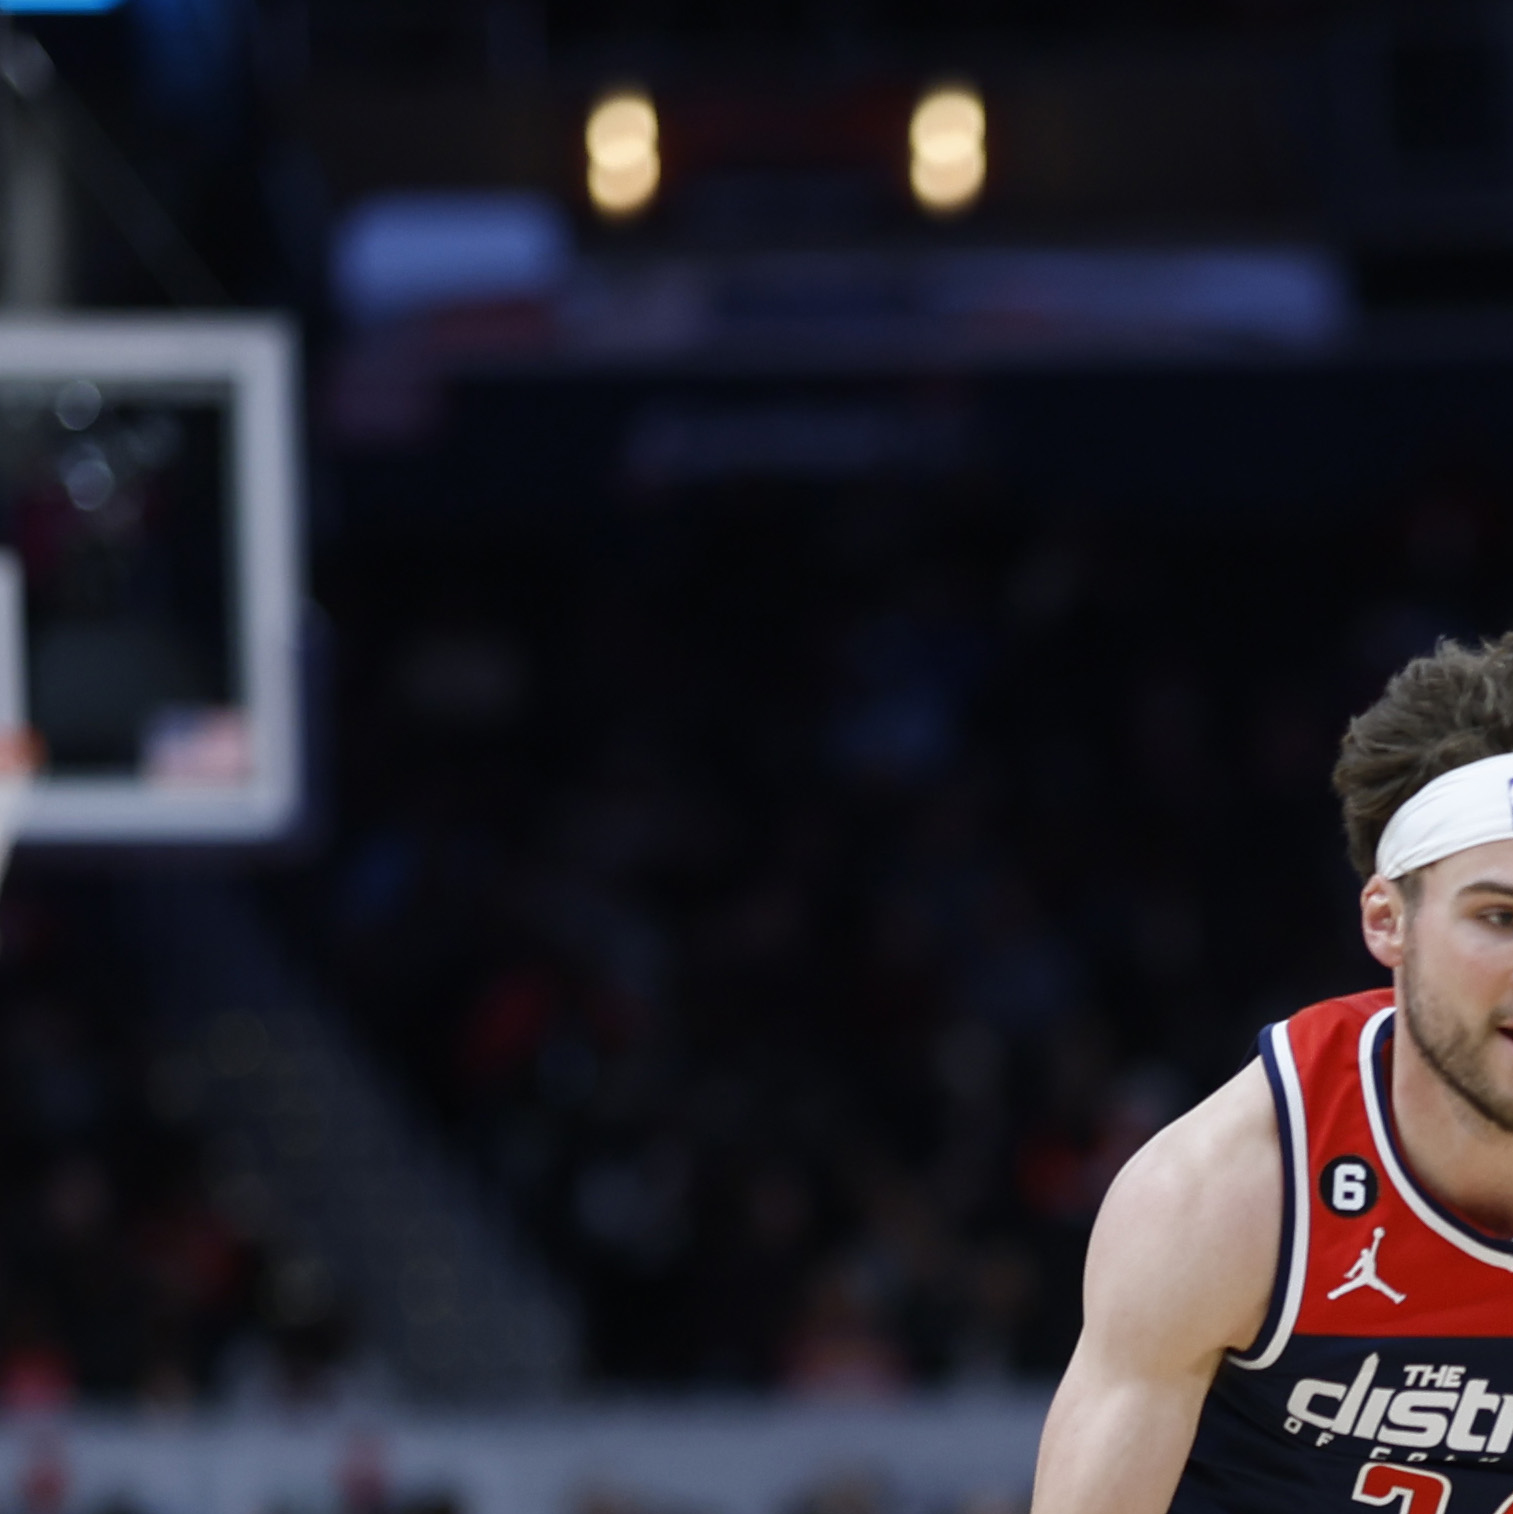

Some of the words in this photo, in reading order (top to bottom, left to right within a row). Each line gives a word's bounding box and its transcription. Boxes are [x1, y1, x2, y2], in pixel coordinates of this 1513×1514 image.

[1331, 1162, 1367, 1212] 6
[1402, 1363, 1467, 1390] THE
[1283, 1416, 1335, 1448] OF
